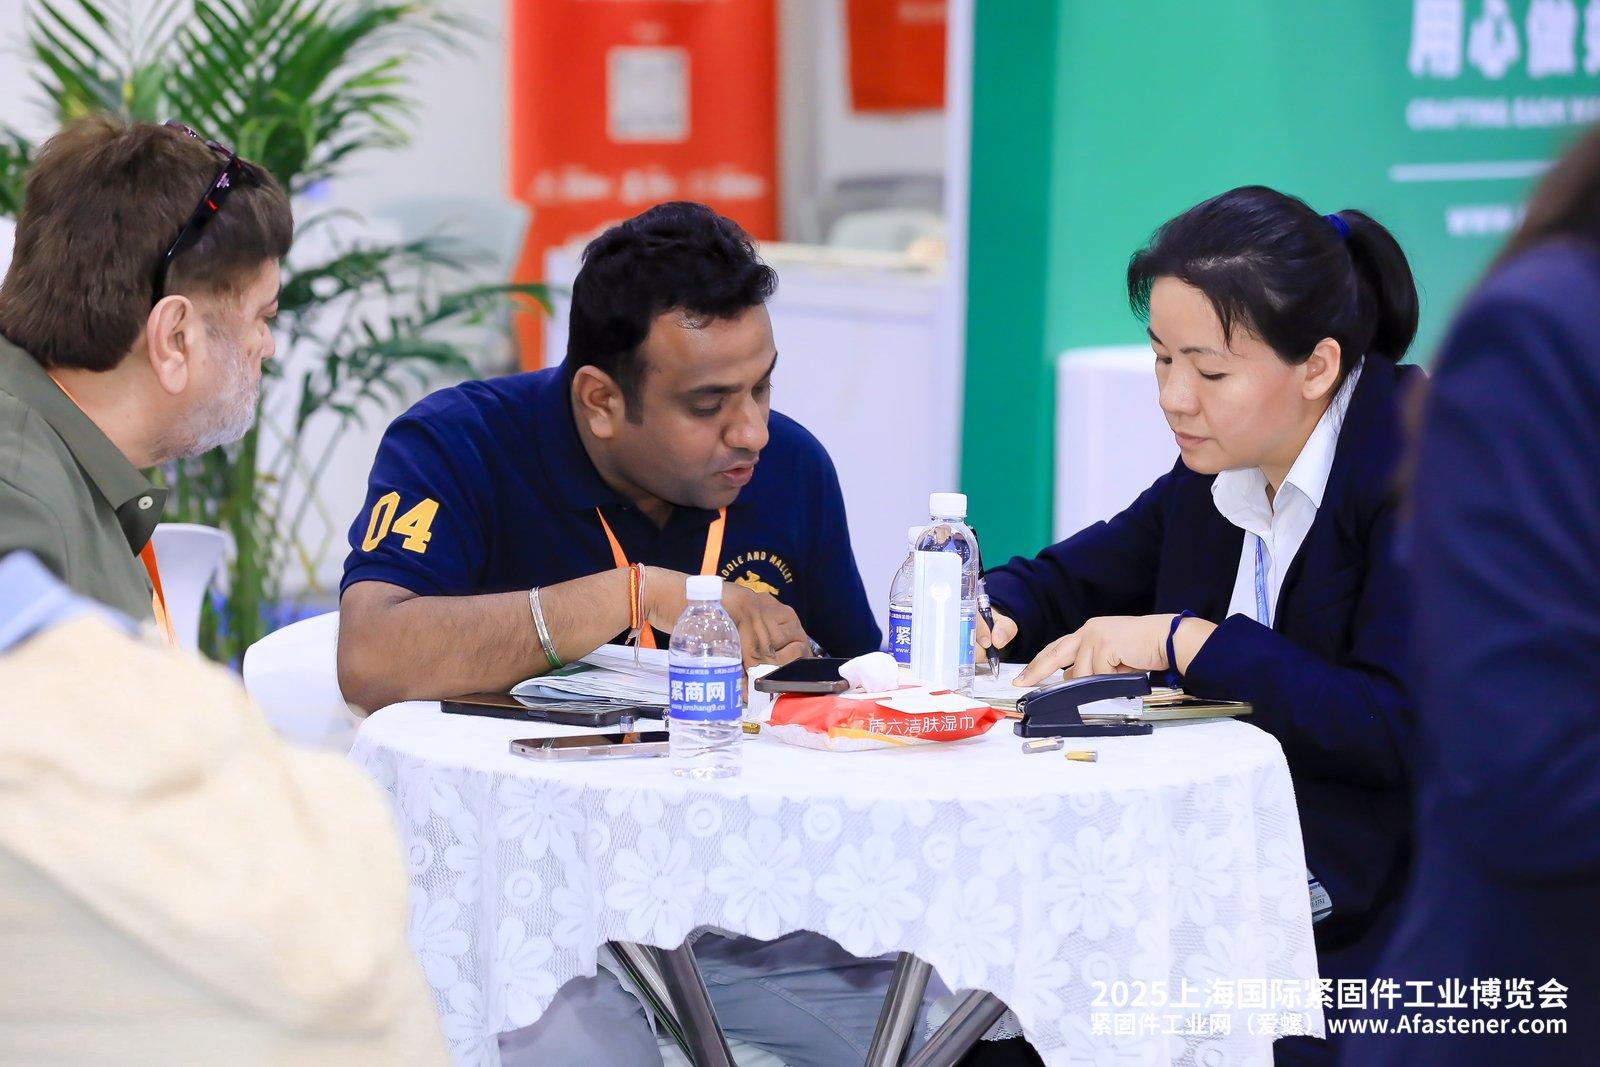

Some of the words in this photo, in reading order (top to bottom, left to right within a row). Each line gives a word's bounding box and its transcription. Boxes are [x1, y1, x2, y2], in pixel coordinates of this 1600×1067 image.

[361, 491, 440, 554] 04
[746, 551, 767, 561] AND
[768, 554, 793, 584] MALLET
[671, 680, 726, 702] 紧商网
